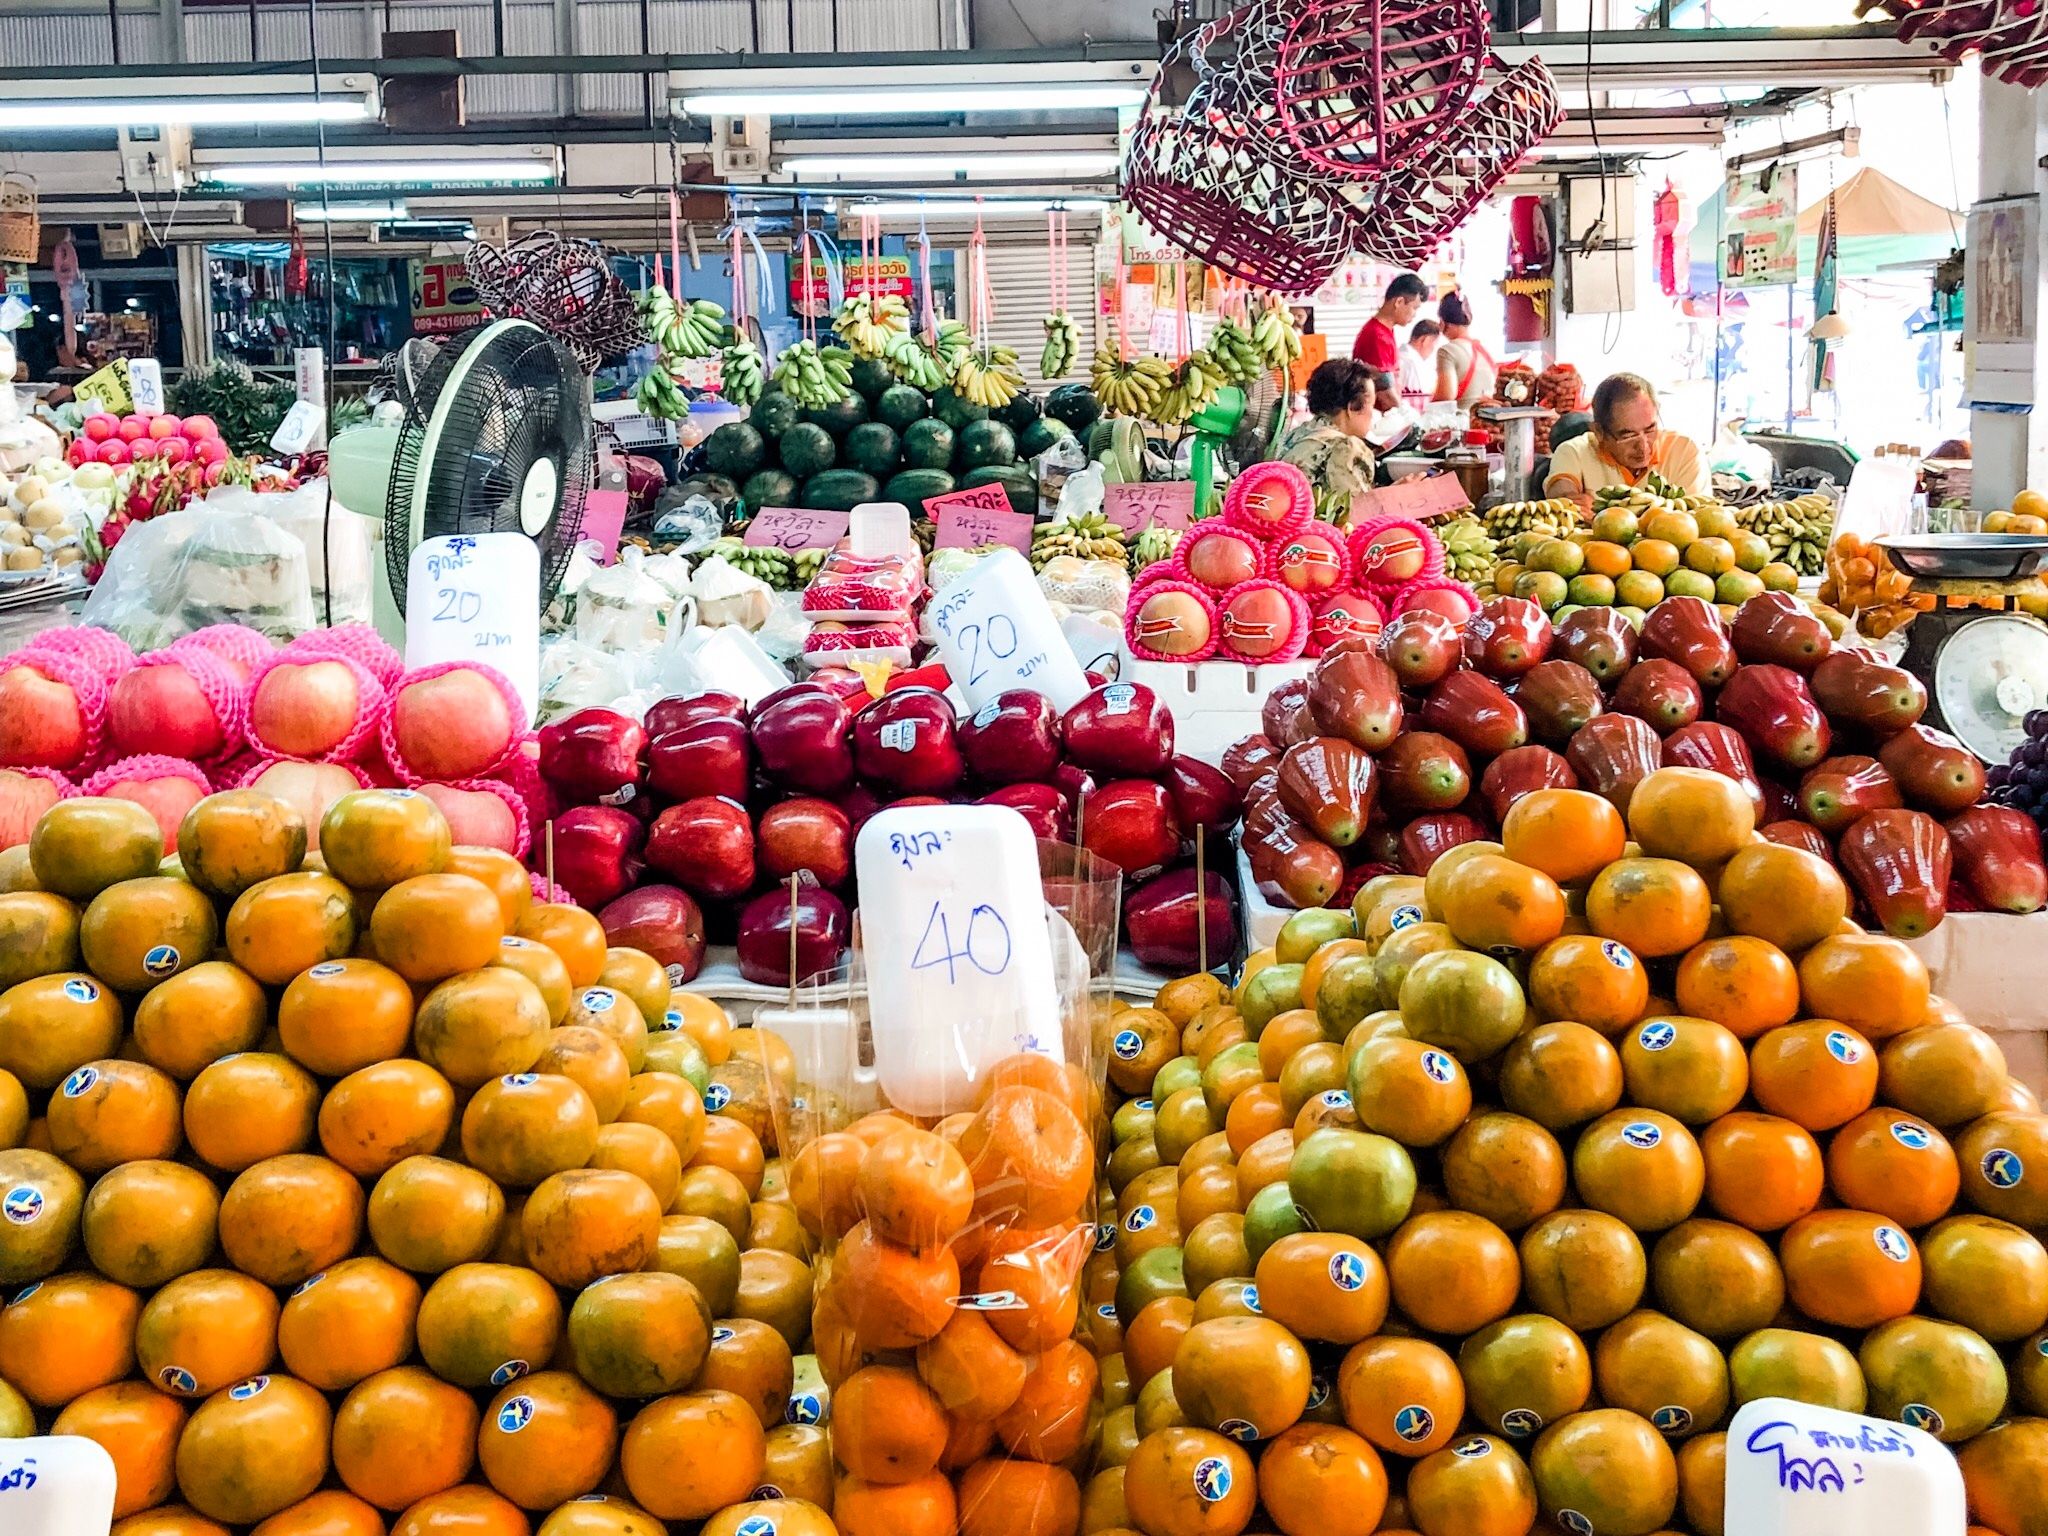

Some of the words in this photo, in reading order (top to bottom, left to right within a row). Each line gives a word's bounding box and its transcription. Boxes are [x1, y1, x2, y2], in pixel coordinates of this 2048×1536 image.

[432, 588, 482, 623] 20
[957, 614, 1018, 686] 20
[911, 901, 1011, 985] 40
